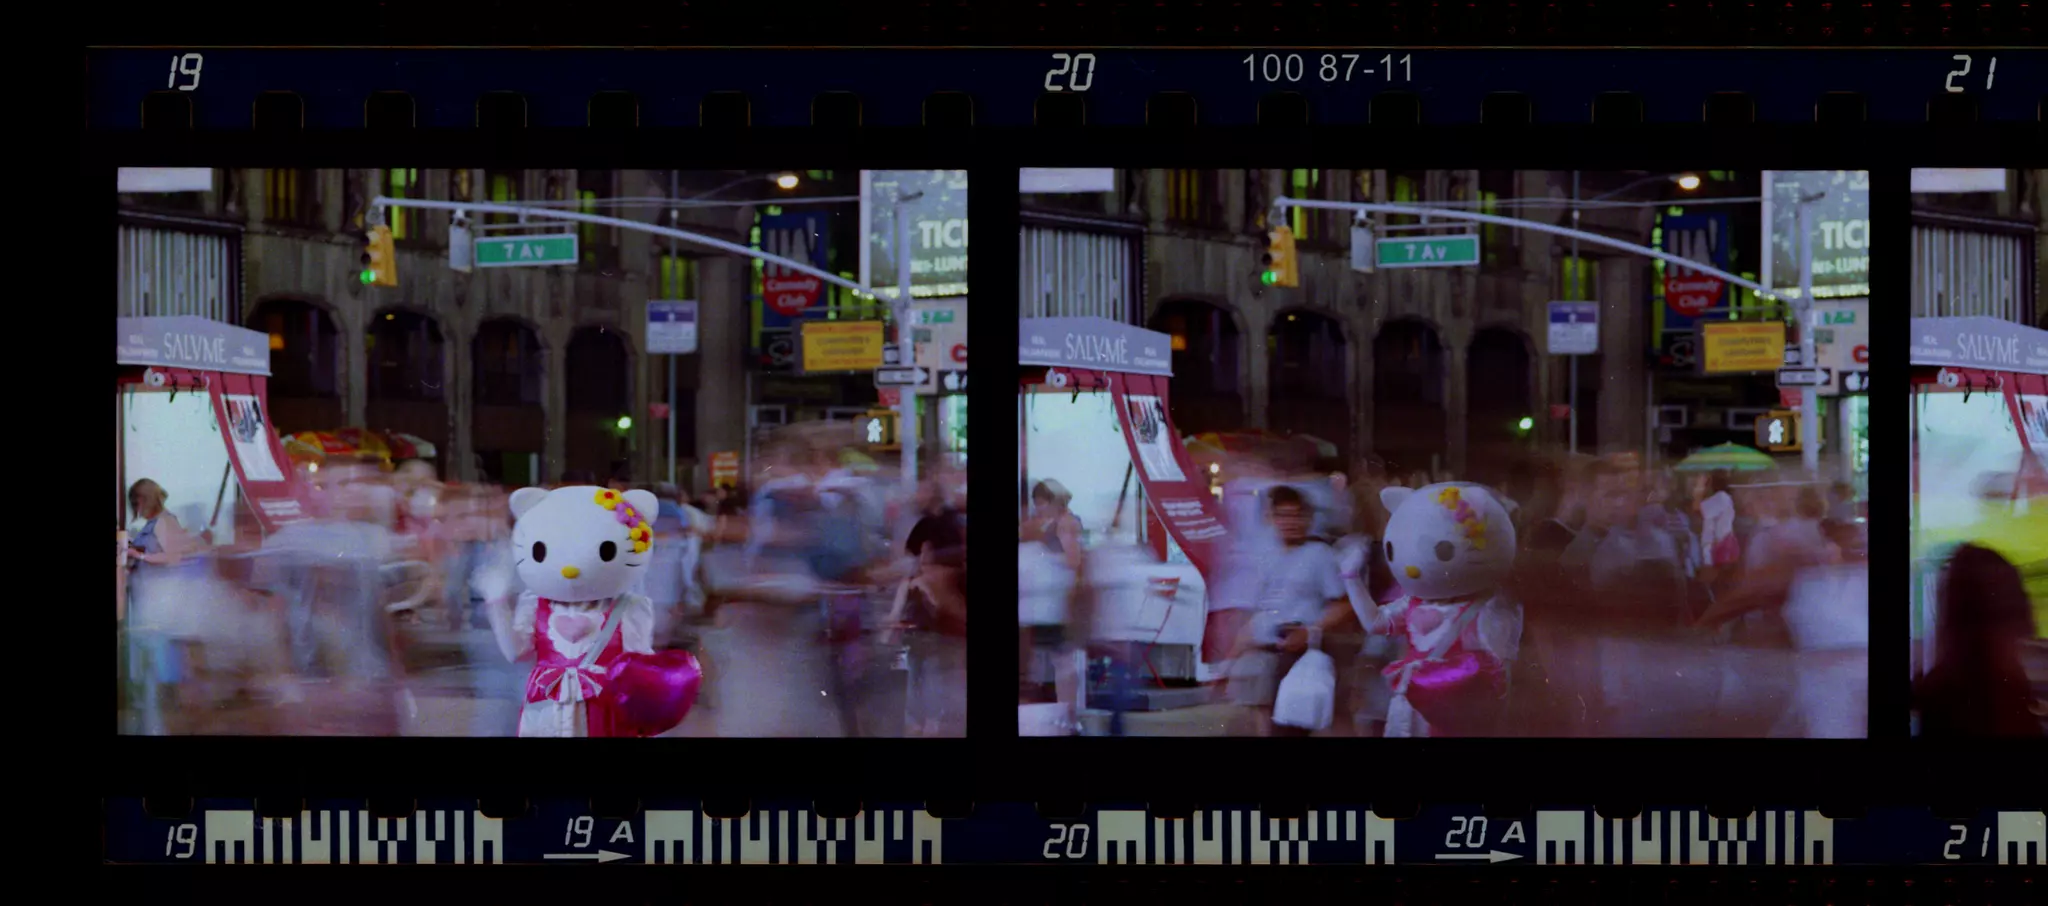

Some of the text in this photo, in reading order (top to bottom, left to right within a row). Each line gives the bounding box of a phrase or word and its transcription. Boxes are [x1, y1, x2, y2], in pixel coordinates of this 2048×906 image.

[167, 53, 202, 91] 19
[1044, 53, 1096, 91] 20
[1243, 53, 1412, 82] 100 87-11
[1945, 54, 1997, 92] 21
[918, 218, 968, 249] TIC
[1819, 218, 1870, 250] TIC
[165, 822, 198, 859] 19
[564, 815, 634, 848] 19 A
[1042, 823, 1090, 859] 20
[1445, 816, 1526, 848] 20 A
[1943, 825, 1990, 859] 21
